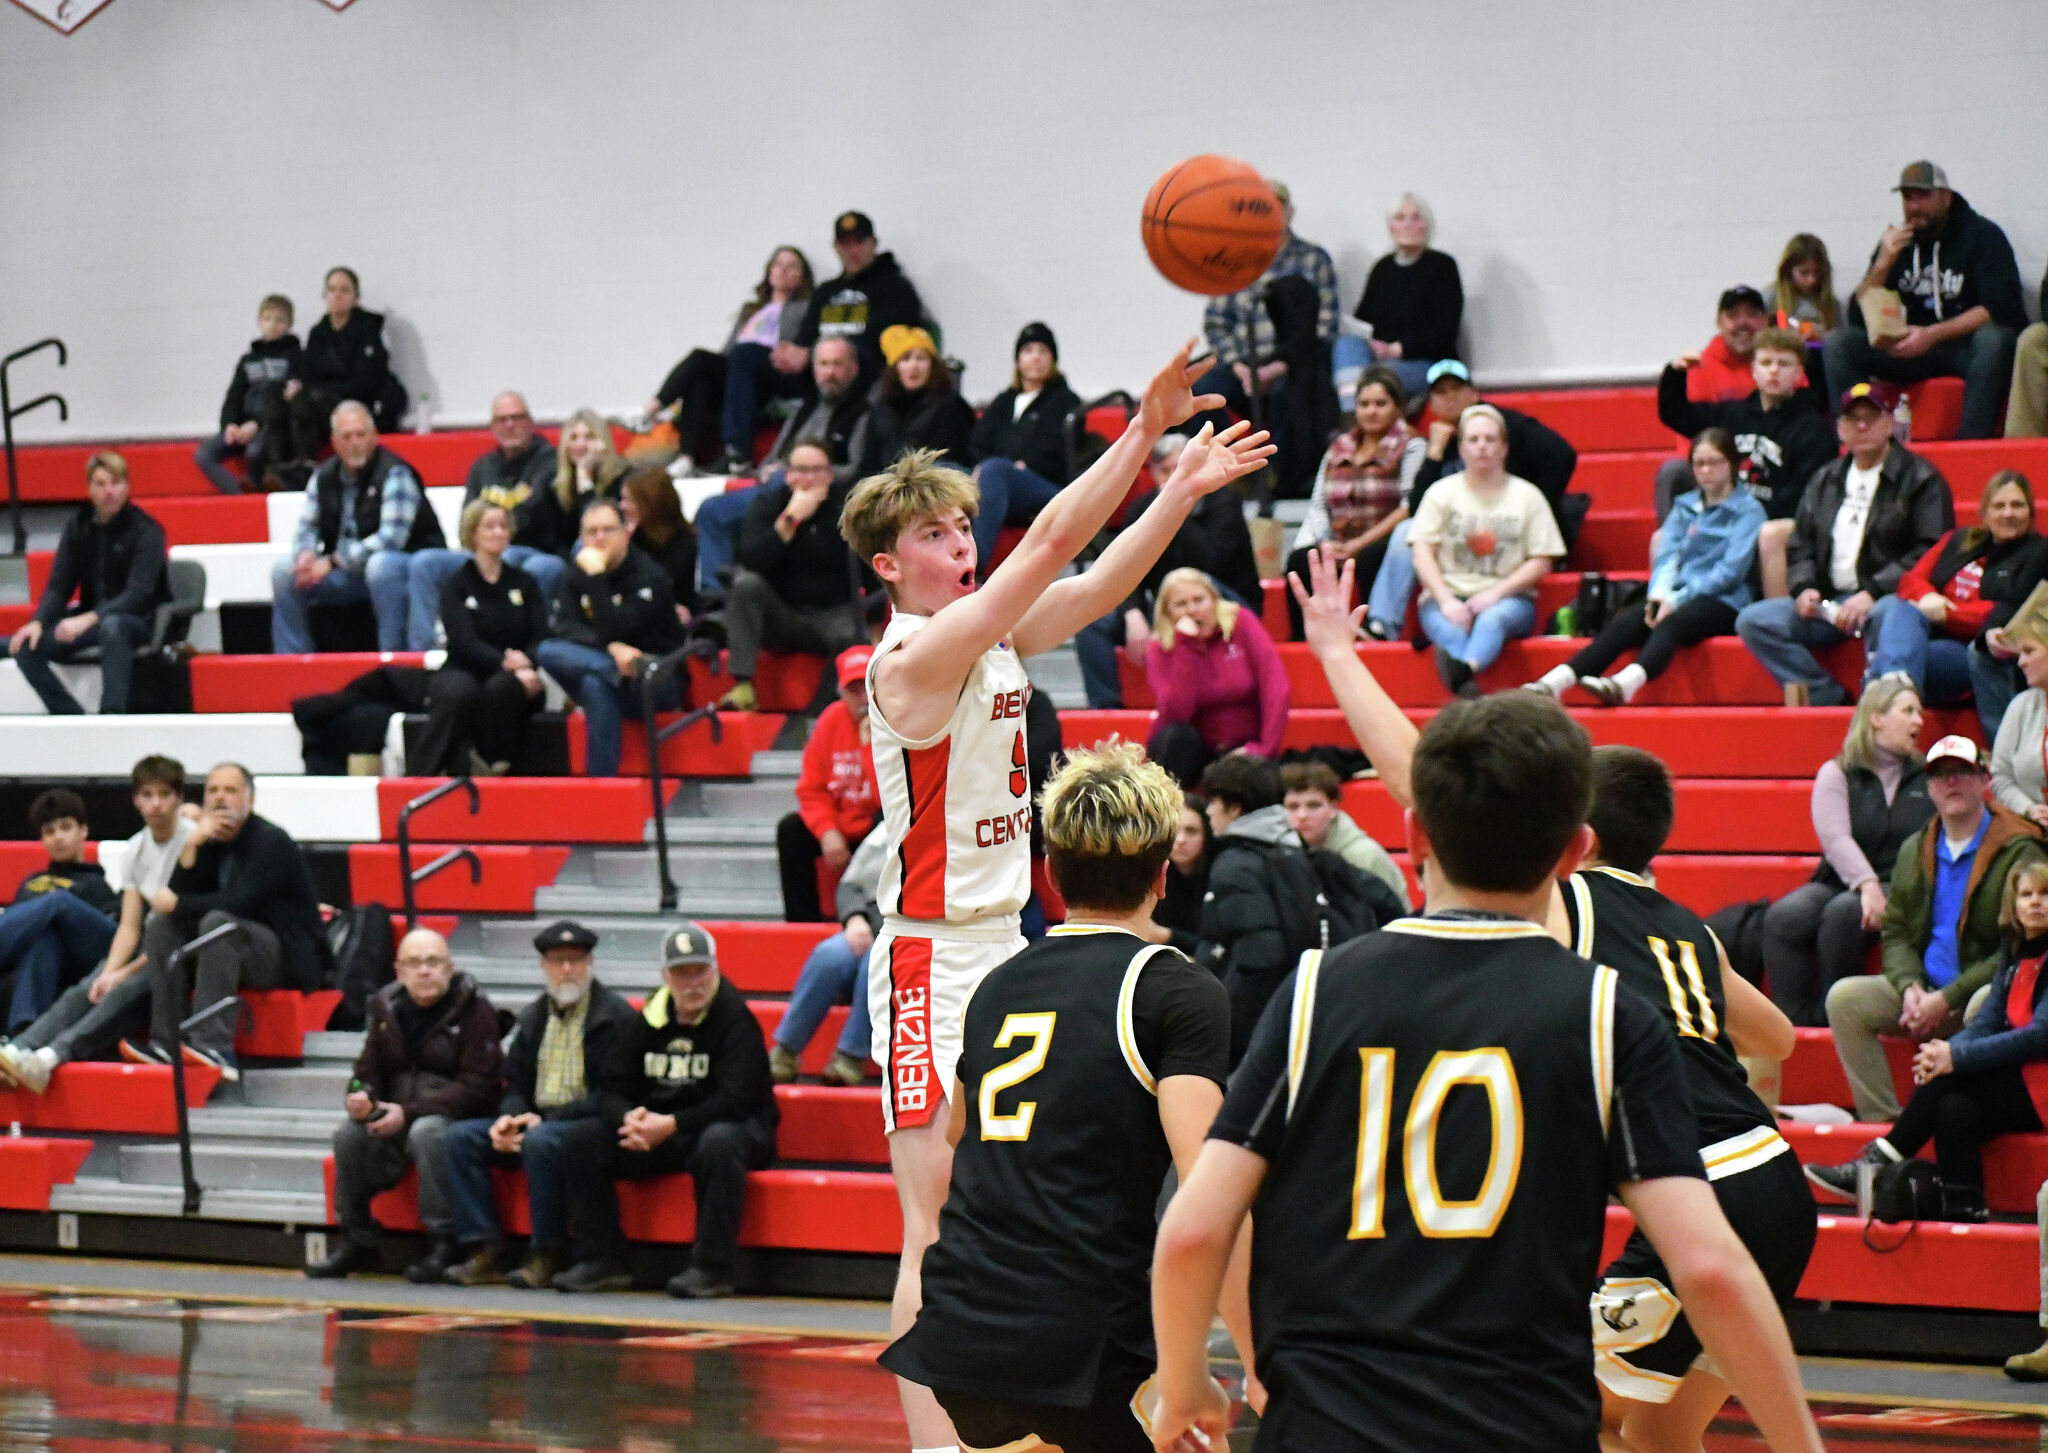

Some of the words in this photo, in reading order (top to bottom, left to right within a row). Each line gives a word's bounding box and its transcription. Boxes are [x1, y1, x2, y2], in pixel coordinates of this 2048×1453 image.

[895, 986, 930, 1112] BENZIE
[1646, 935, 1719, 1045] 11
[979, 1011, 1057, 1142] 2
[1347, 1047, 1524, 1240] 10
